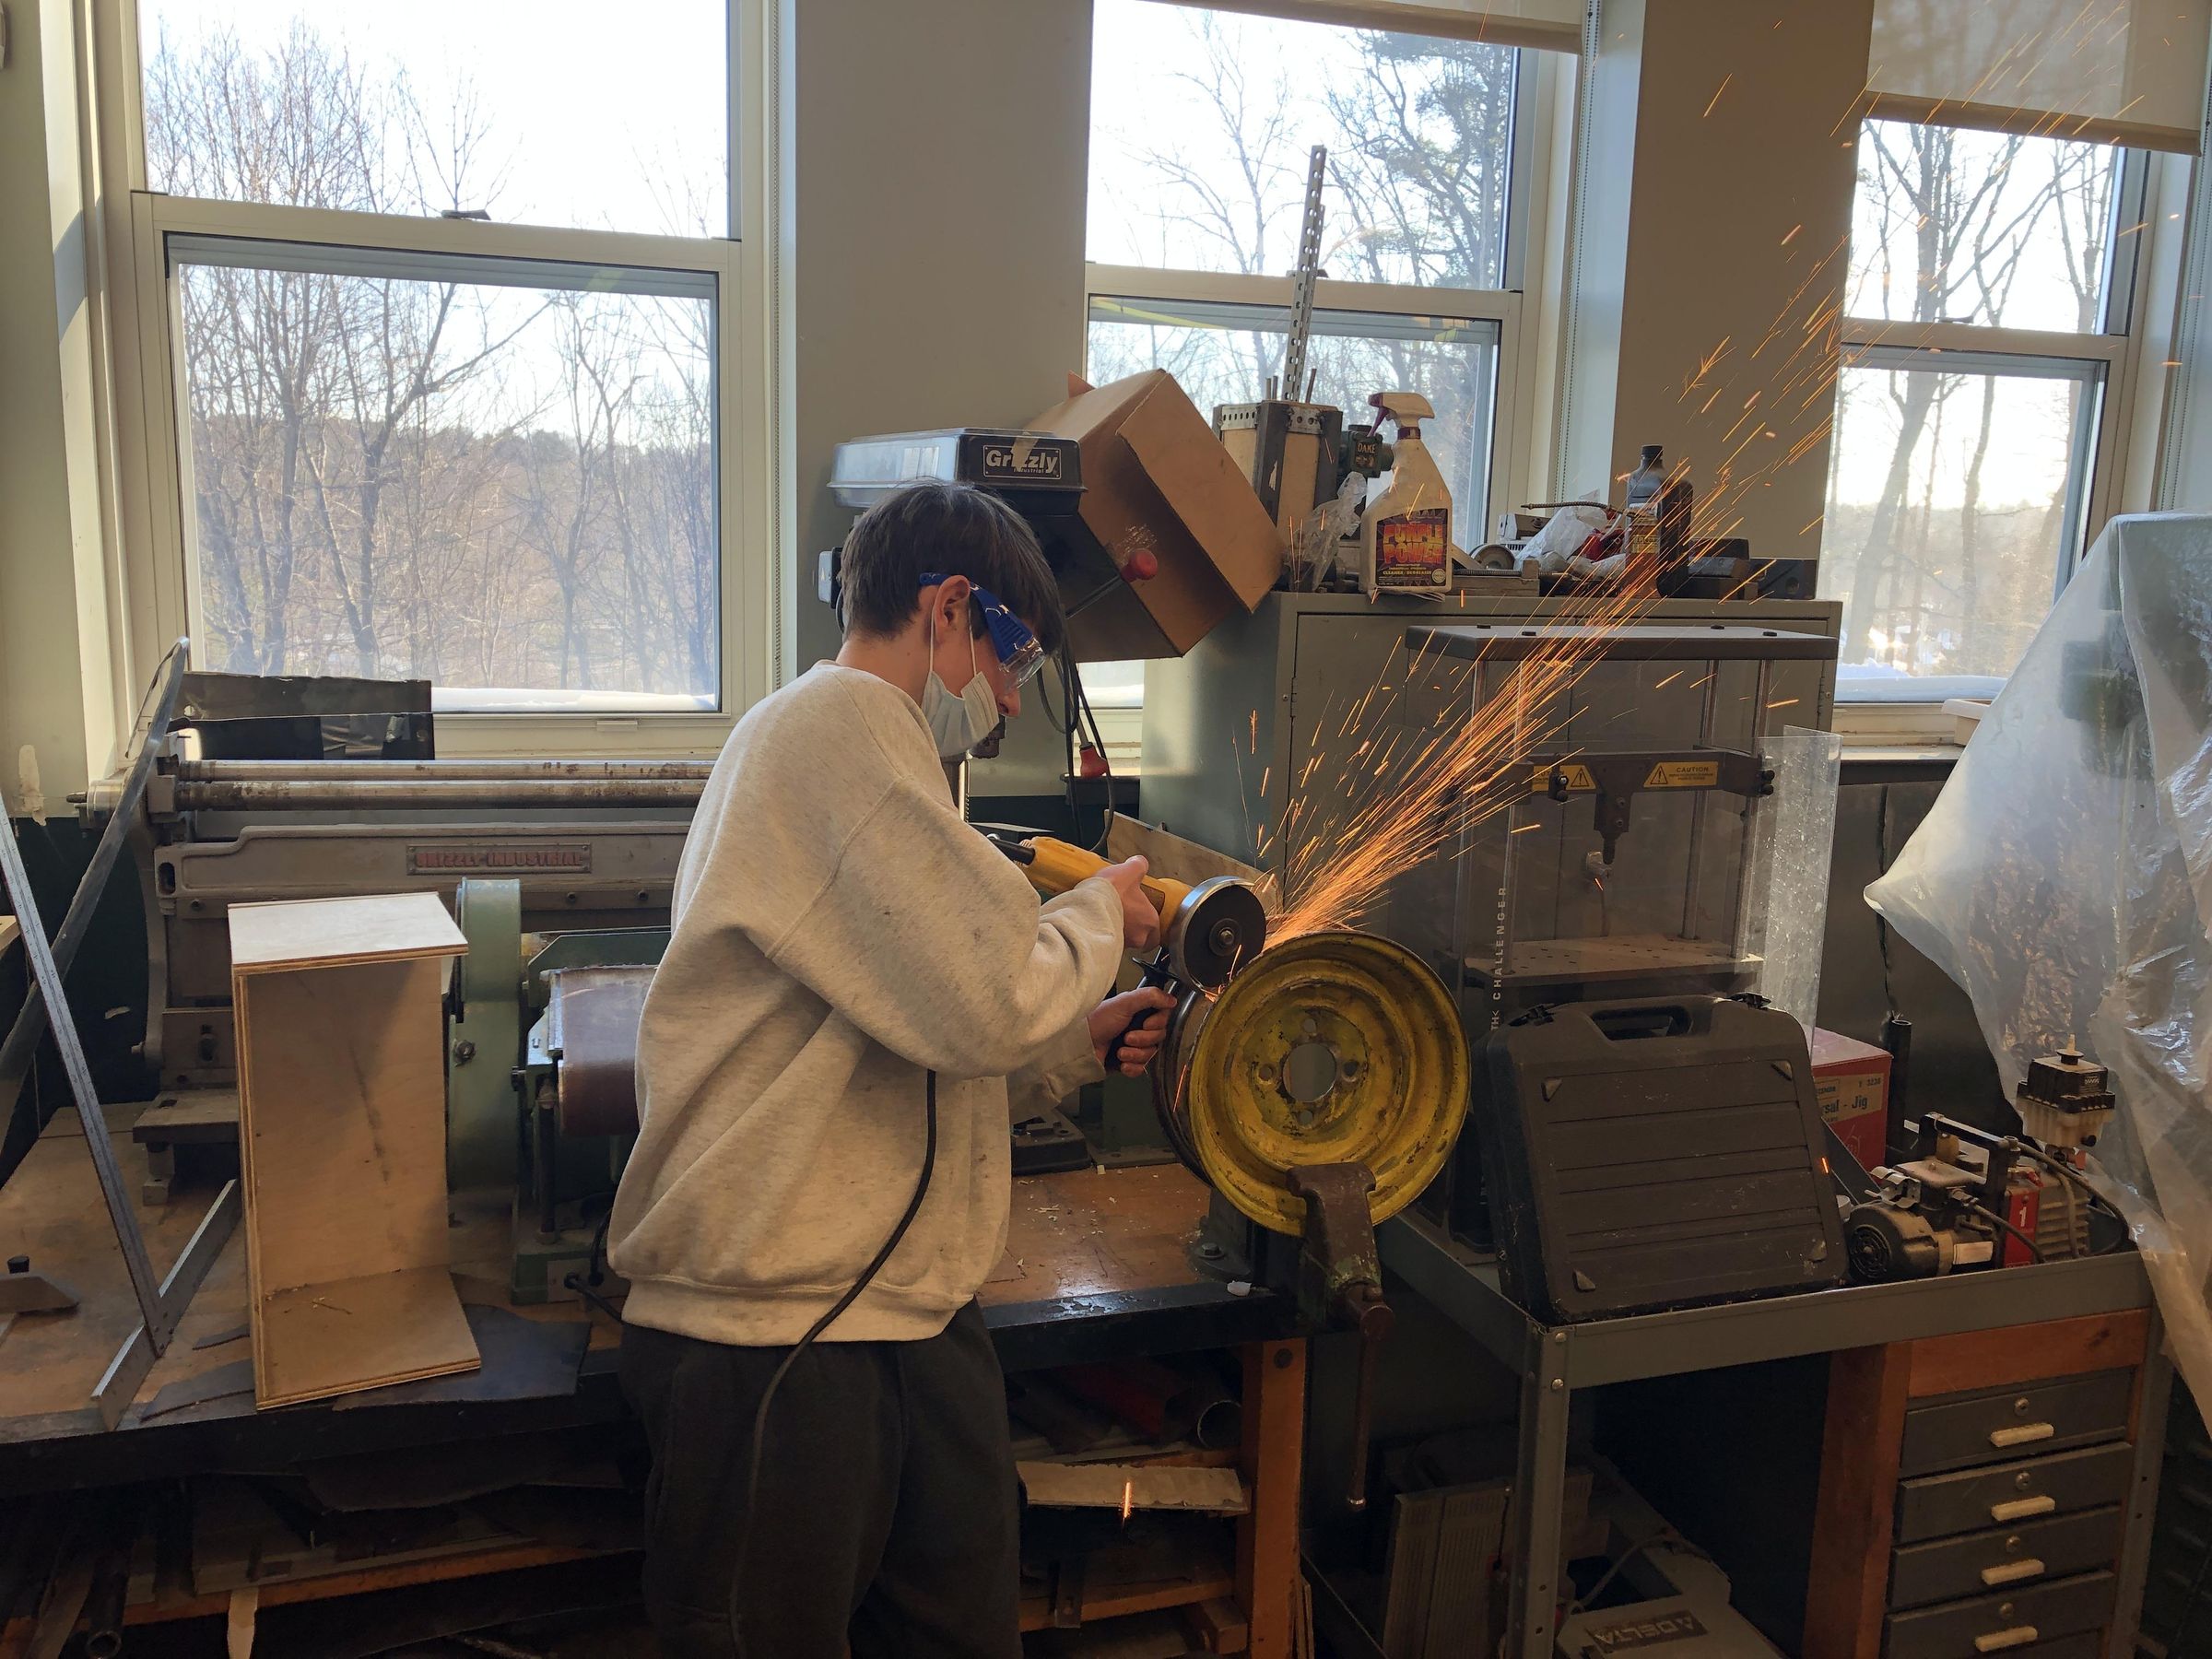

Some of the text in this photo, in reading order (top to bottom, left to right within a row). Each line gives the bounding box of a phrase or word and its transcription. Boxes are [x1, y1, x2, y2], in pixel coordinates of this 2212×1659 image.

[986, 450, 1058, 473] Grzly
[1383, 542, 1444, 564] POWER
[486, 851, 583, 867] INDUSTRIAL
[1492, 887, 1507, 1001] CHALLENGER
[1851, 1095, 1868, 1111] Jig
[2018, 1206, 2027, 1227] 1
[1594, 1620, 1678, 1645] DELTA
